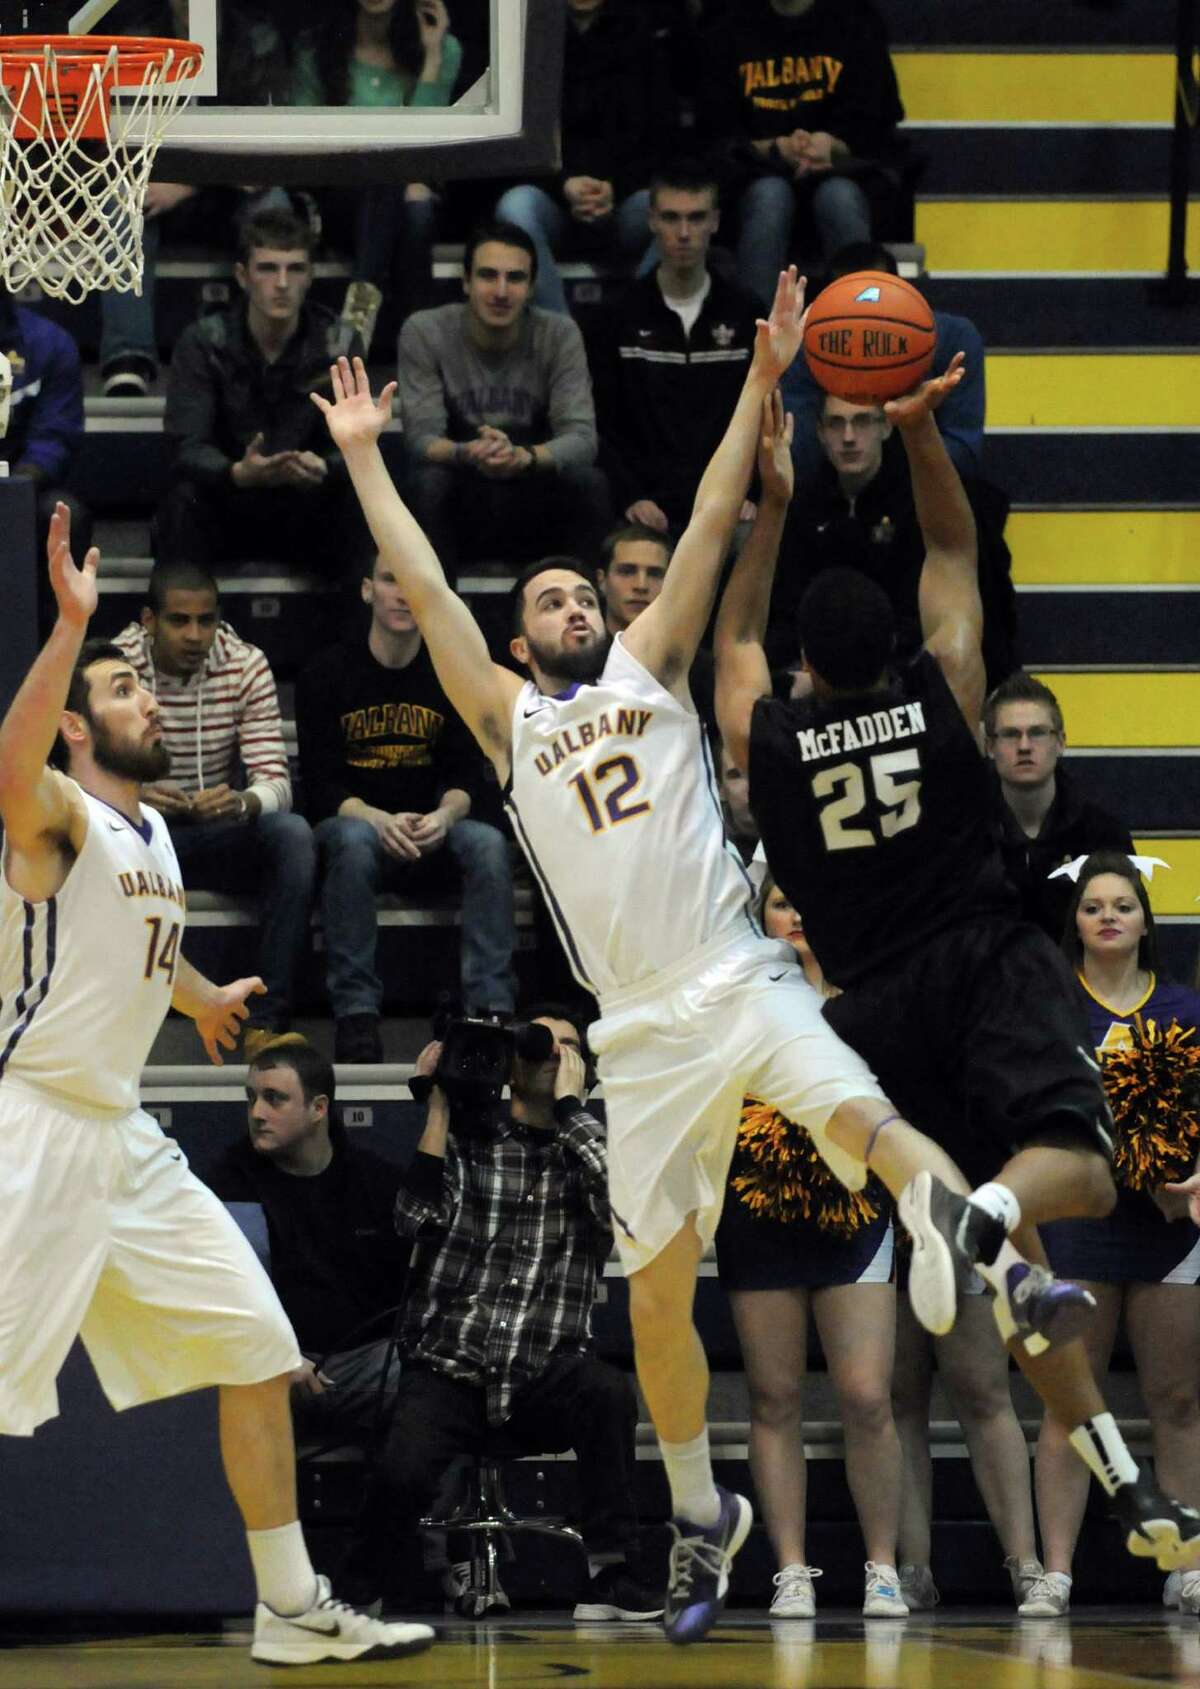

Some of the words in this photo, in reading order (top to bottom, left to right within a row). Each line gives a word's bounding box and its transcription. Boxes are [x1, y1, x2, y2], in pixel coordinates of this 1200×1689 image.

[819, 329, 853, 357] THE
[534, 708, 653, 776] UALBANY
[796, 701, 927, 762] McFADDEN
[567, 753, 653, 836] 12
[811, 748, 922, 851] 25
[144, 915, 180, 985] 14
[353, 1111, 365, 1123] 10
